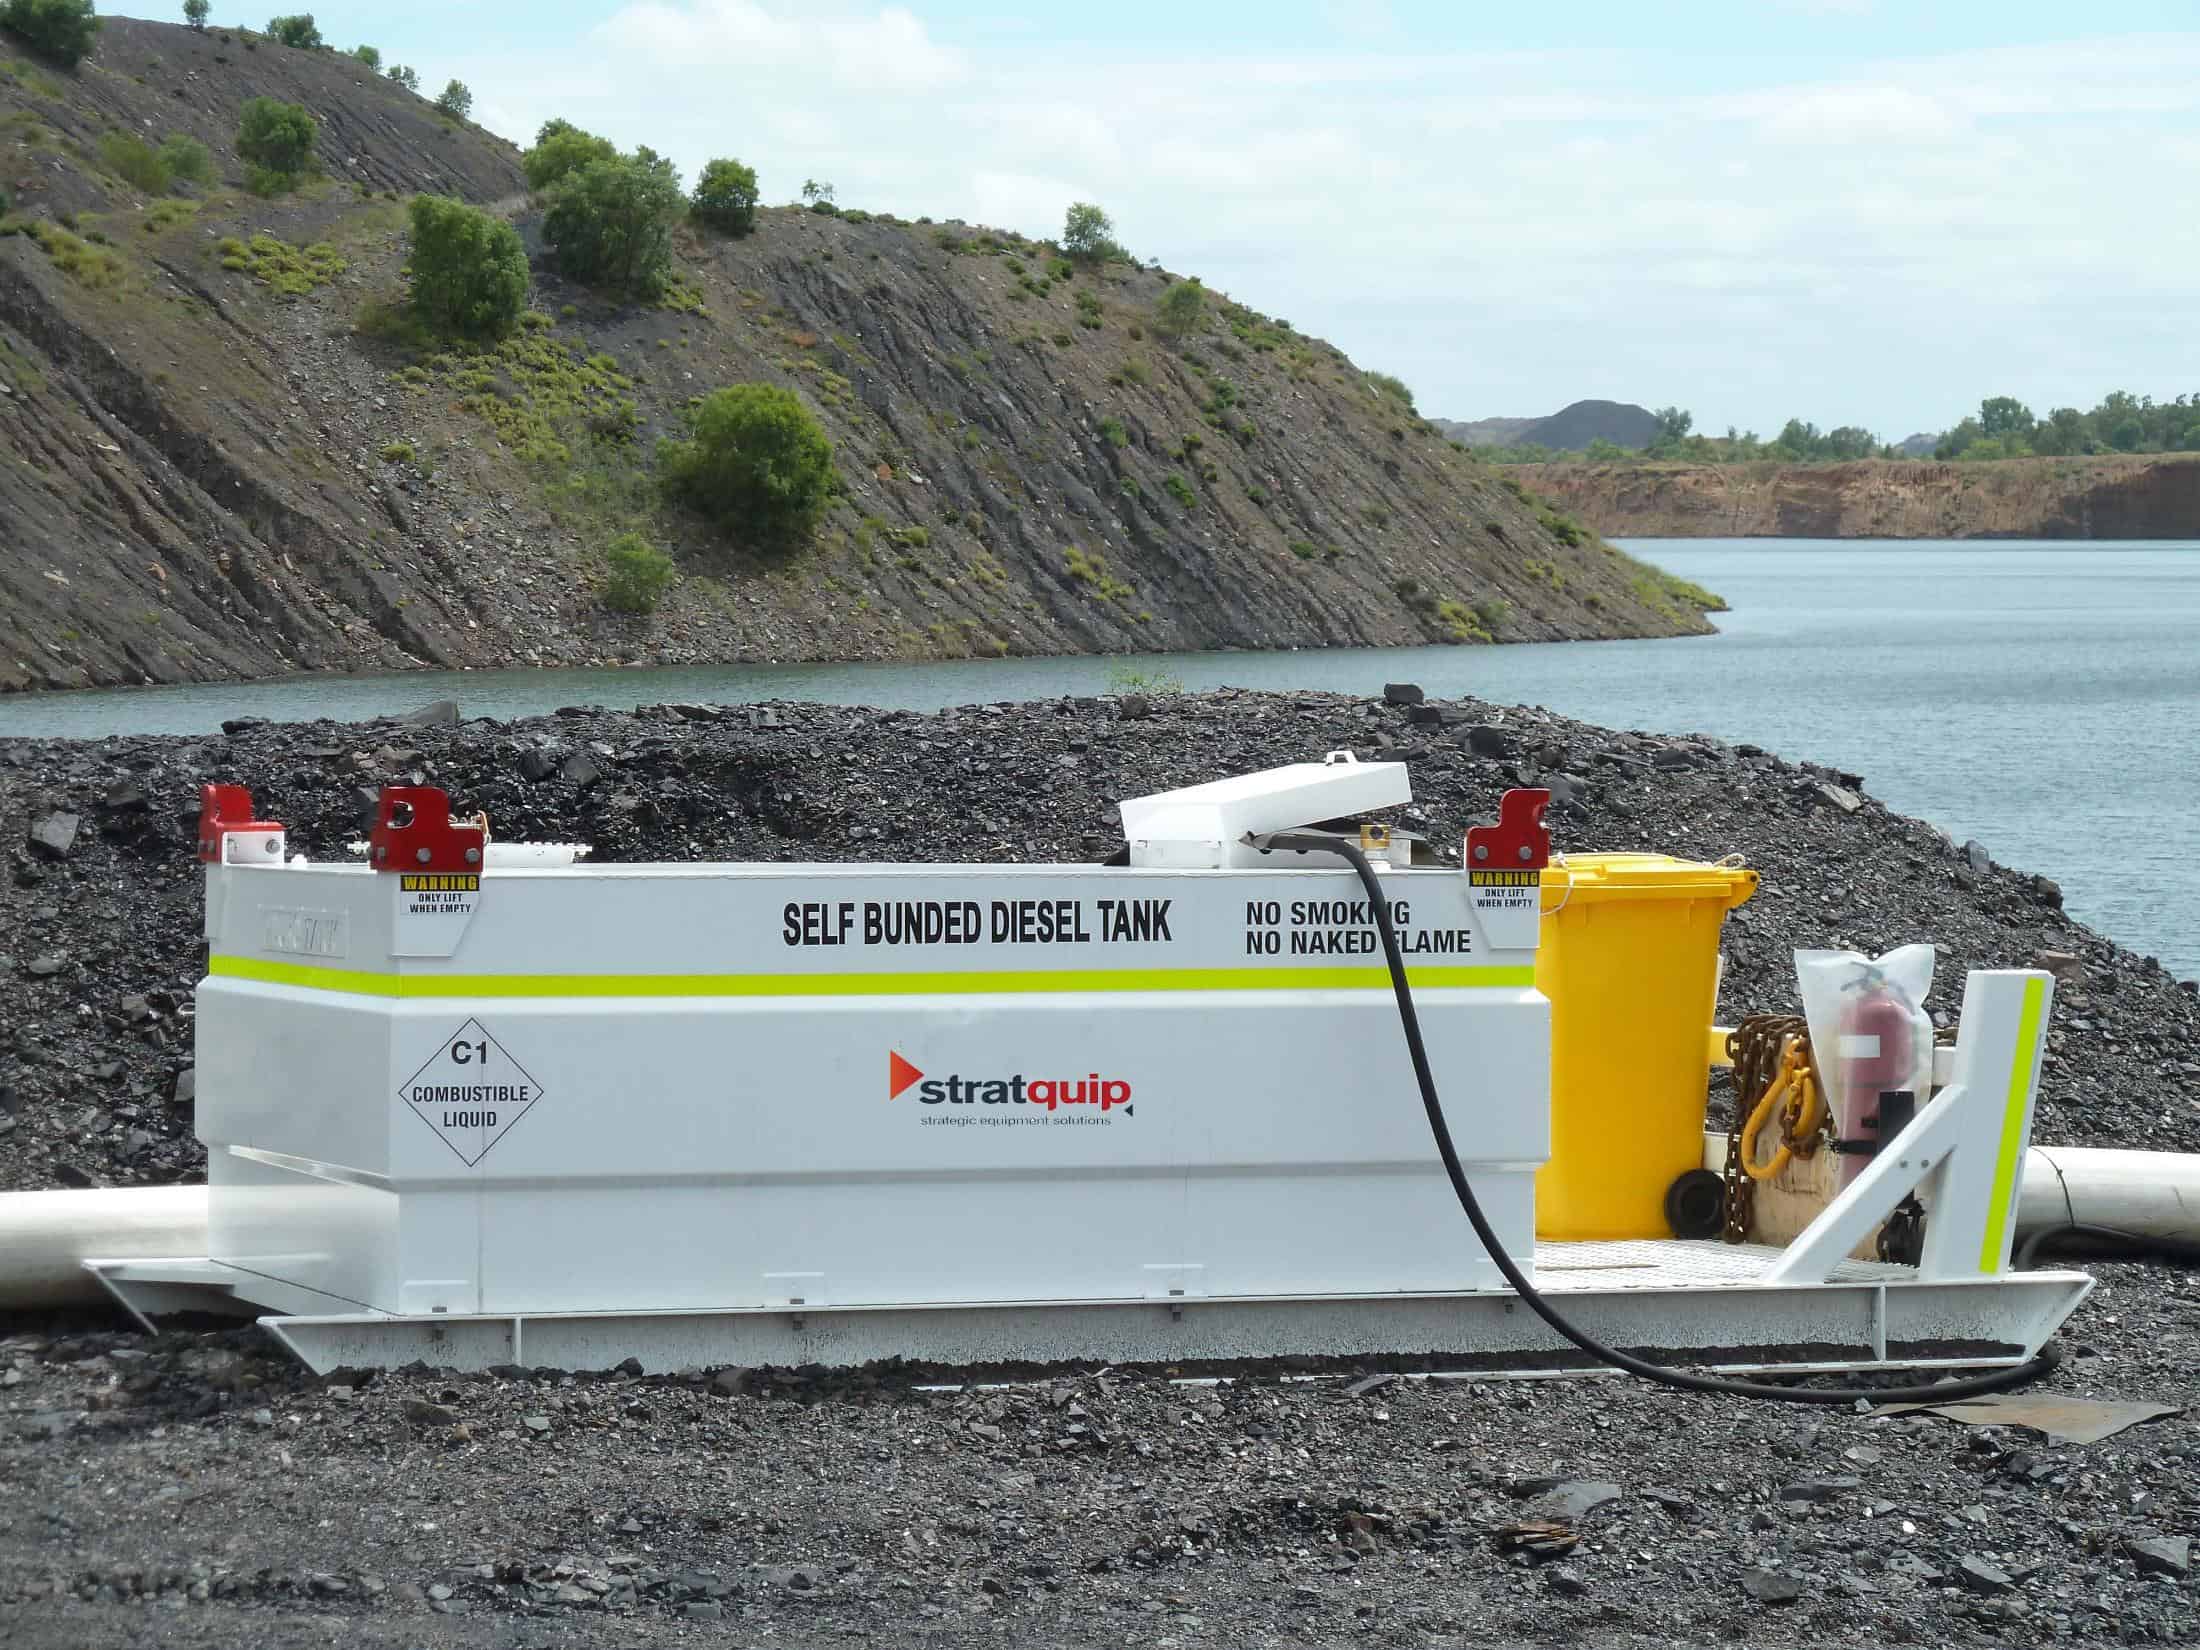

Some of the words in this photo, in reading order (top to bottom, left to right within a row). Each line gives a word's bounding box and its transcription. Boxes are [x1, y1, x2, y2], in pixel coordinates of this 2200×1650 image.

[404, 876, 477, 890] WARNING
[1471, 872, 1538, 885] WARNING
[418, 893, 440, 902] ONLY
[444, 893, 462, 902] LIFT
[1485, 888, 1505, 897] ONLY
[1508, 888, 1525, 897] LIFT
[409, 904, 437, 913] WHEN
[440, 904, 471, 913] EMPTY
[1477, 899, 1502, 908] WHEN
[1505, 899, 1532, 908] EMPTY
[1246, 901, 1281, 926] NO
[1290, 901, 1410, 926] SMOKIG
[783, 902, 855, 946] SELF
[864, 901, 982, 945] BUNDED
[992, 900, 1090, 944] DIESEL
[1096, 899, 1172, 942] TANK
[1246, 930, 1281, 955] NO
[1291, 930, 1377, 954] NAKED
[451, 1040, 487, 1065] C1
[412, 1086, 529, 1102] COMBUSTIBLE
[919, 1073, 1132, 1111] stratquip
[443, 1111, 497, 1128] LIQUID
[919, 1115, 976, 1128] strategic
[979, 1115, 1049, 1128] equipment
[1053, 1115, 1112, 1126] solutions
